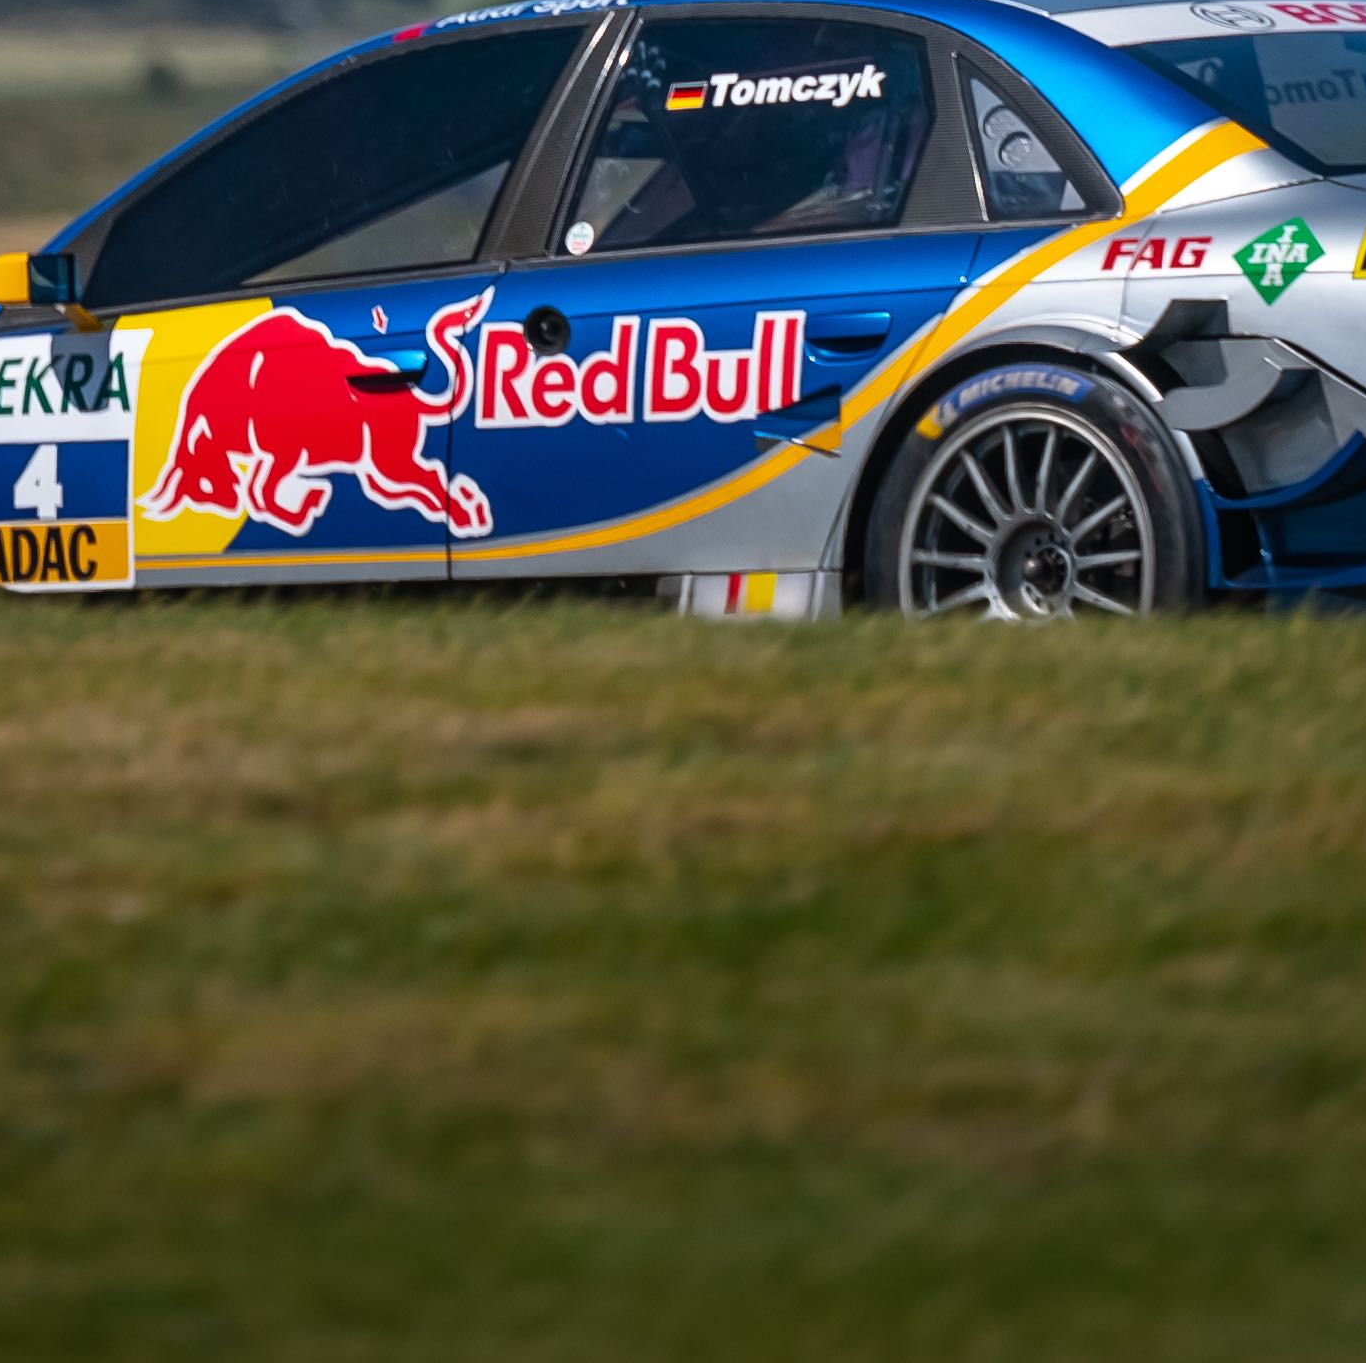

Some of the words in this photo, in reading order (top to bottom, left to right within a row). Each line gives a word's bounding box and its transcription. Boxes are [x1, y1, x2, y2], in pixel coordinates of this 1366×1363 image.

[710, 64, 886, 108] Tomczyk
[1101, 235, 1213, 272] FAG
[479, 321, 636, 422] Red
[647, 315, 801, 416] Bull
[12, 443, 64, 521] 4
